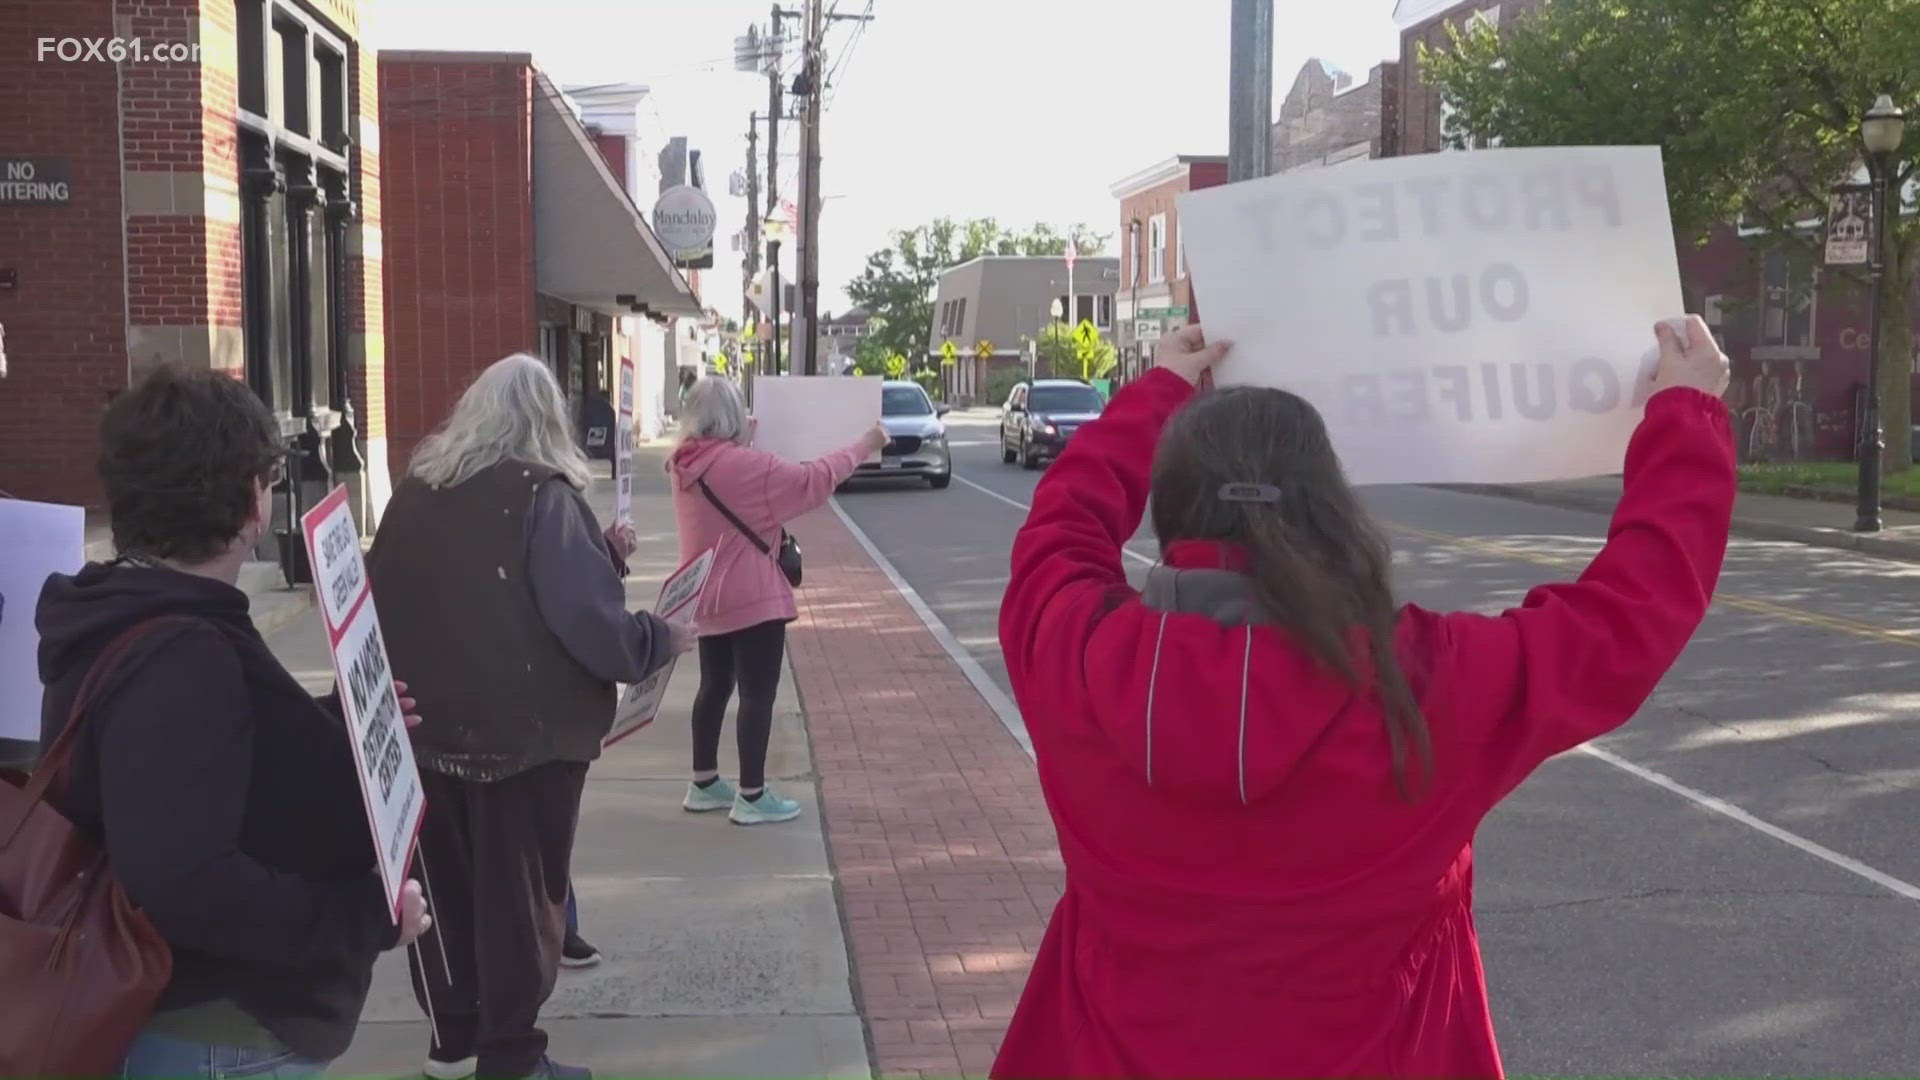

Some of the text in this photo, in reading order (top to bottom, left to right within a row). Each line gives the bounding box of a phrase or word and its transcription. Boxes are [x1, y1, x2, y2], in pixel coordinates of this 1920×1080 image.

[8, 162, 35, 180] NO
[654, 208, 716, 228] Mandalay
[1139, 323, 1149, 337] P
[347, 624, 385, 724] NO MORE
